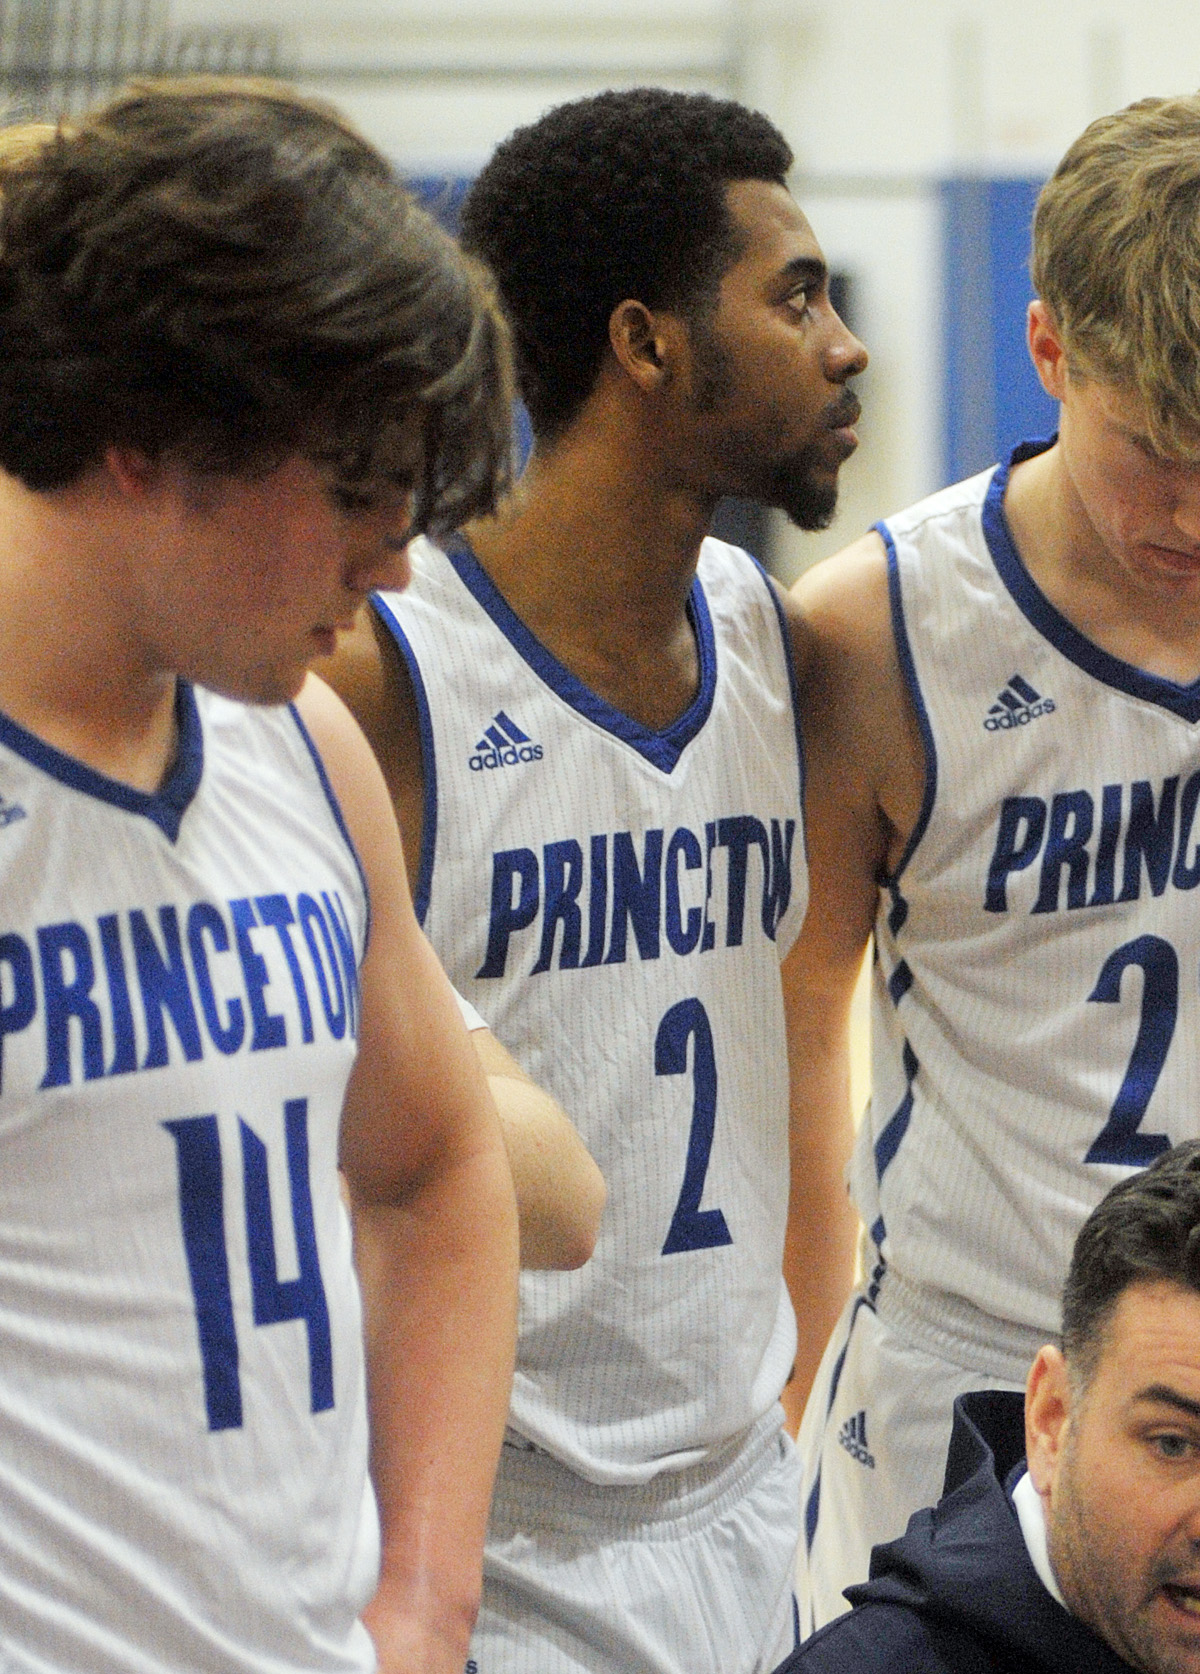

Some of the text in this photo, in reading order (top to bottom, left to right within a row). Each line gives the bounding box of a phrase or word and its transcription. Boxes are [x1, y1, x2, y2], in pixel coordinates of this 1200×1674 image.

[469, 742, 544, 772] adidas
[984, 698, 1055, 732] adidas
[654, 997, 733, 1255] 2
[161, 1098, 335, 1432] 14
